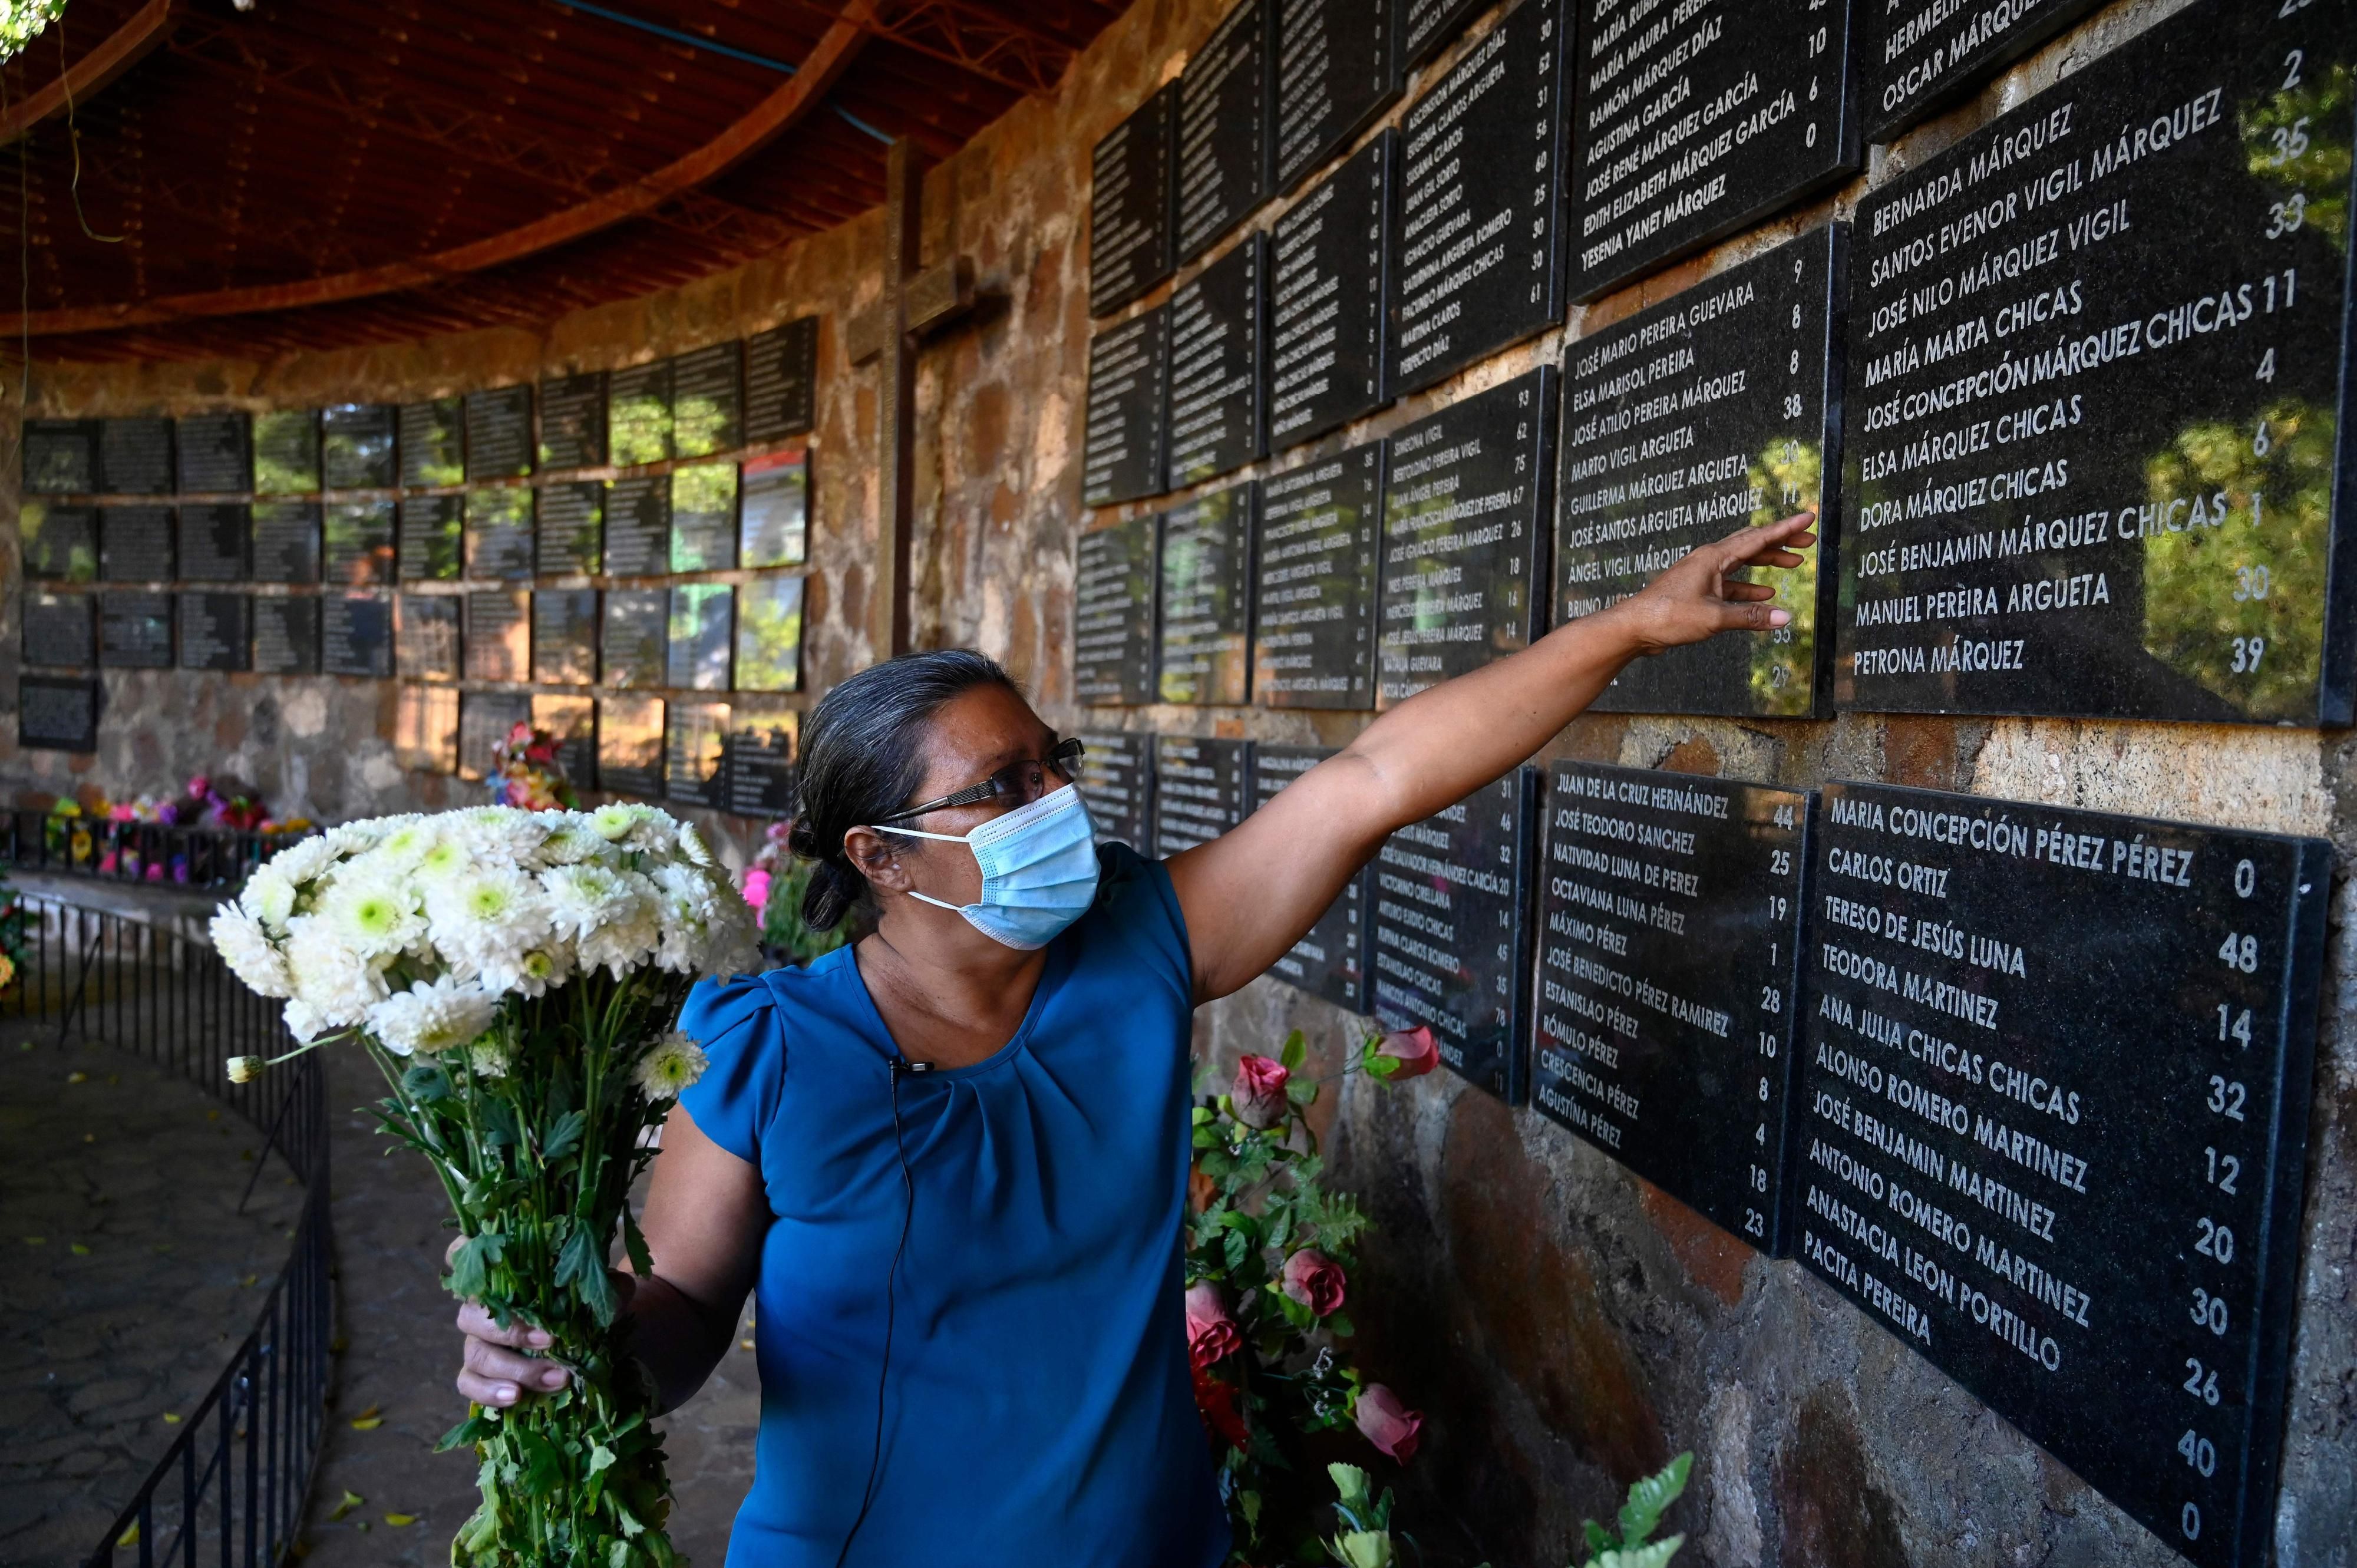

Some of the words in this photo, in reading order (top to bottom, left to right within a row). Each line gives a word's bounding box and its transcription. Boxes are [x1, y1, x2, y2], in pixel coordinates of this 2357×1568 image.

[1589, 85, 1630, 131] RAMÓN
[1631, 39, 1689, 100] MÁRQUEZ
[1692, 15, 1722, 57] DÍAZ
[1883, 48, 1944, 112] OSCAR
[1948, 0, 2041, 68] MÁRQUE
[1583, 203, 1611, 237] EDITH
[1613, 169, 1667, 219] ELIZABETH
[1669, 128, 1732, 187] MÁRQUEZ
[1735, 88, 1795, 144] GARCÍA
[1809, 75, 1818, 101] 6
[1584, 163, 1611, 202] JOSÉ
[1613, 144, 1639, 184] RENÉ
[1641, 110, 1701, 166] MÁRQUEZ
[1703, 71, 1758, 126] GARCÍA
[1808, 27, 1827, 58] 10
[1587, 115, 1640, 167] AGUSTINA
[1642, 75, 1691, 126] GARCÍA
[1870, 233, 1935, 288] SANTOS
[1940, 192, 2017, 254] EVENOR
[2024, 159, 2082, 211] VIGIL
[2089, 87, 2221, 182] MÁRQUEZ
[2282, 49, 2303, 91] 2
[1873, 167, 1962, 237] BERNARDA
[1968, 102, 2072, 187] MÁRQUEZ
[1581, 233, 1623, 272] YESENIA
[1626, 210, 1662, 248] YANET
[1663, 173, 1726, 228] MÁRQUEZ
[1805, 123, 1816, 148] 0
[1868, 288, 1907, 338] JOSÉ
[1912, 278, 1953, 318] NILO
[1958, 229, 2059, 299] MÁRQUEZ
[2068, 199, 2130, 250] VIGIL
[2270, 115, 2309, 167] 35
[1573, 388, 1596, 412] ELSA
[1597, 367, 1646, 402] MARISOL
[1648, 347, 1694, 384] PEREIRA
[1792, 303, 1801, 329] 8
[1574, 346, 1599, 381] JOSÉ
[1600, 333, 1637, 368] MARIO
[1640, 312, 1686, 349] PEREIRA
[1688, 281, 1755, 326] GUEVARA
[1794, 259, 1803, 283] 9
[1864, 389, 1900, 433] JOSÉ
[1903, 349, 2029, 421] CONCEPCIÓN
[2032, 320, 2141, 384] MÁRQUEZ
[2145, 284, 2253, 349] CHICAS
[2263, 268, 2295, 313] 11
[1571, 455, 1607, 483] MARTO
[1609, 444, 1638, 469] VIGIL
[1640, 425, 1694, 461] ARGUETA
[1783, 394, 1802, 420] 38
[1572, 414, 1597, 447] JOSÉ
[1599, 409, 1631, 438] ATILIO
[1634, 392, 1678, 425] PEREIRA
[1681, 369, 1745, 410] MÁRQUEZ
[1790, 349, 1799, 375] 8
[1863, 450, 1897, 482] ELSA
[1902, 420, 1990, 472] MÁRQUEZ
[1996, 394, 2082, 444] CHICAS
[2255, 347, 2275, 383] 4
[1569, 520, 1593, 549] JOSÉ
[1595, 517, 1636, 544] SANTOS
[1638, 504, 1694, 536] ARGUETA
[1696, 482, 1764, 524] MÁRQUEZ
[1860, 499, 1902, 533] DORA
[1905, 477, 1987, 520] MÁRQUEZ
[1990, 458, 2068, 501] CHICAS
[2253, 421, 2270, 458] 6
[1568, 557, 1602, 584] ÁNGEL
[1604, 556, 1632, 577] VIGIL
[1568, 597, 1602, 618] BRUNO
[1856, 596, 1922, 627] MANUEL
[2006, 572, 2110, 613] ARGUETA
[2233, 564, 2270, 603] 30
[1853, 646, 1926, 676] PETRONA
[1930, 634, 2025, 674] MÁRQUEZ
[2230, 635, 2264, 674] 39
[1555, 807, 1580, 831] JOSÉ
[1582, 813, 1635, 842] TEODORO
[1637, 823, 1695, 855] SANCHEZ
[1770, 849, 1790, 876] 25
[1557, 773, 1584, 795] JUAN
[1587, 777, 1600, 798] DE
[1602, 780, 1616, 801] LA
[1619, 782, 1649, 806] CRUZ
[1651, 784, 1729, 819] HERNÁNDEZ
[1773, 804, 1794, 831] 44
[1831, 797, 1884, 833] MARIA
[1889, 806, 2028, 857] CONCEPCIÓN
[2035, 822, 2105, 871] PÉREZ
[2111, 834, 2194, 887] PÉREZ
[2234, 859, 2255, 898] 0
[1547, 946, 1572, 972] JOSÉ
[1573, 955, 1632, 996] BENEDICTO
[1635, 978, 1668, 1014] PÉREZ
[1671, 995, 1729, 1038] RAMIREZ
[1759, 1031, 1776, 1058] 10
[1549, 910, 1594, 943] MÁXIMO
[1596, 923, 1627, 956] PÉREZ
[1761, 985, 1780, 1014] 28
[1825, 895, 1881, 933] TERESO
[1884, 912, 1908, 943] DE
[1911, 919, 1964, 959] JESÚS
[1970, 935, 2026, 979] LUNA
[2217, 1003, 2252, 1048] 14
[1545, 979, 1604, 1022] ESTANISLAO
[1606, 1005, 1639, 1039] PÉREZ
[1758, 1077, 1768, 1101] 8
[1818, 994, 1853, 1030] ANA
[1858, 1009, 1902, 1050] JULIA
[1908, 1029, 1983, 1084] CHICAS
[1989, 1061, 2079, 1125] CHICAS
[2204, 1146, 2240, 1195] 12
[1590, 1113, 1621, 1150] PÉREZ
[1744, 1208, 1763, 1237] 23
[1813, 1090, 1850, 1131] JOSÉ
[1854, 1110, 1944, 1182] BENJAMIN
[1948, 1160, 2055, 1243] MARTINEZ
[2190, 1287, 2228, 1335] 30
[1804, 1230, 1858, 1292] PACITA
[1863, 1272, 1931, 1346] PEREIRA
[2181, 1501, 2200, 1540] 0
[1806, 1184, 1899, 1267] ANASTACIA
[1904, 1246, 1954, 1304] LEON
[1959, 1282, 2060, 1371] PORTILLO
[2177, 1428, 2215, 1477] 40
